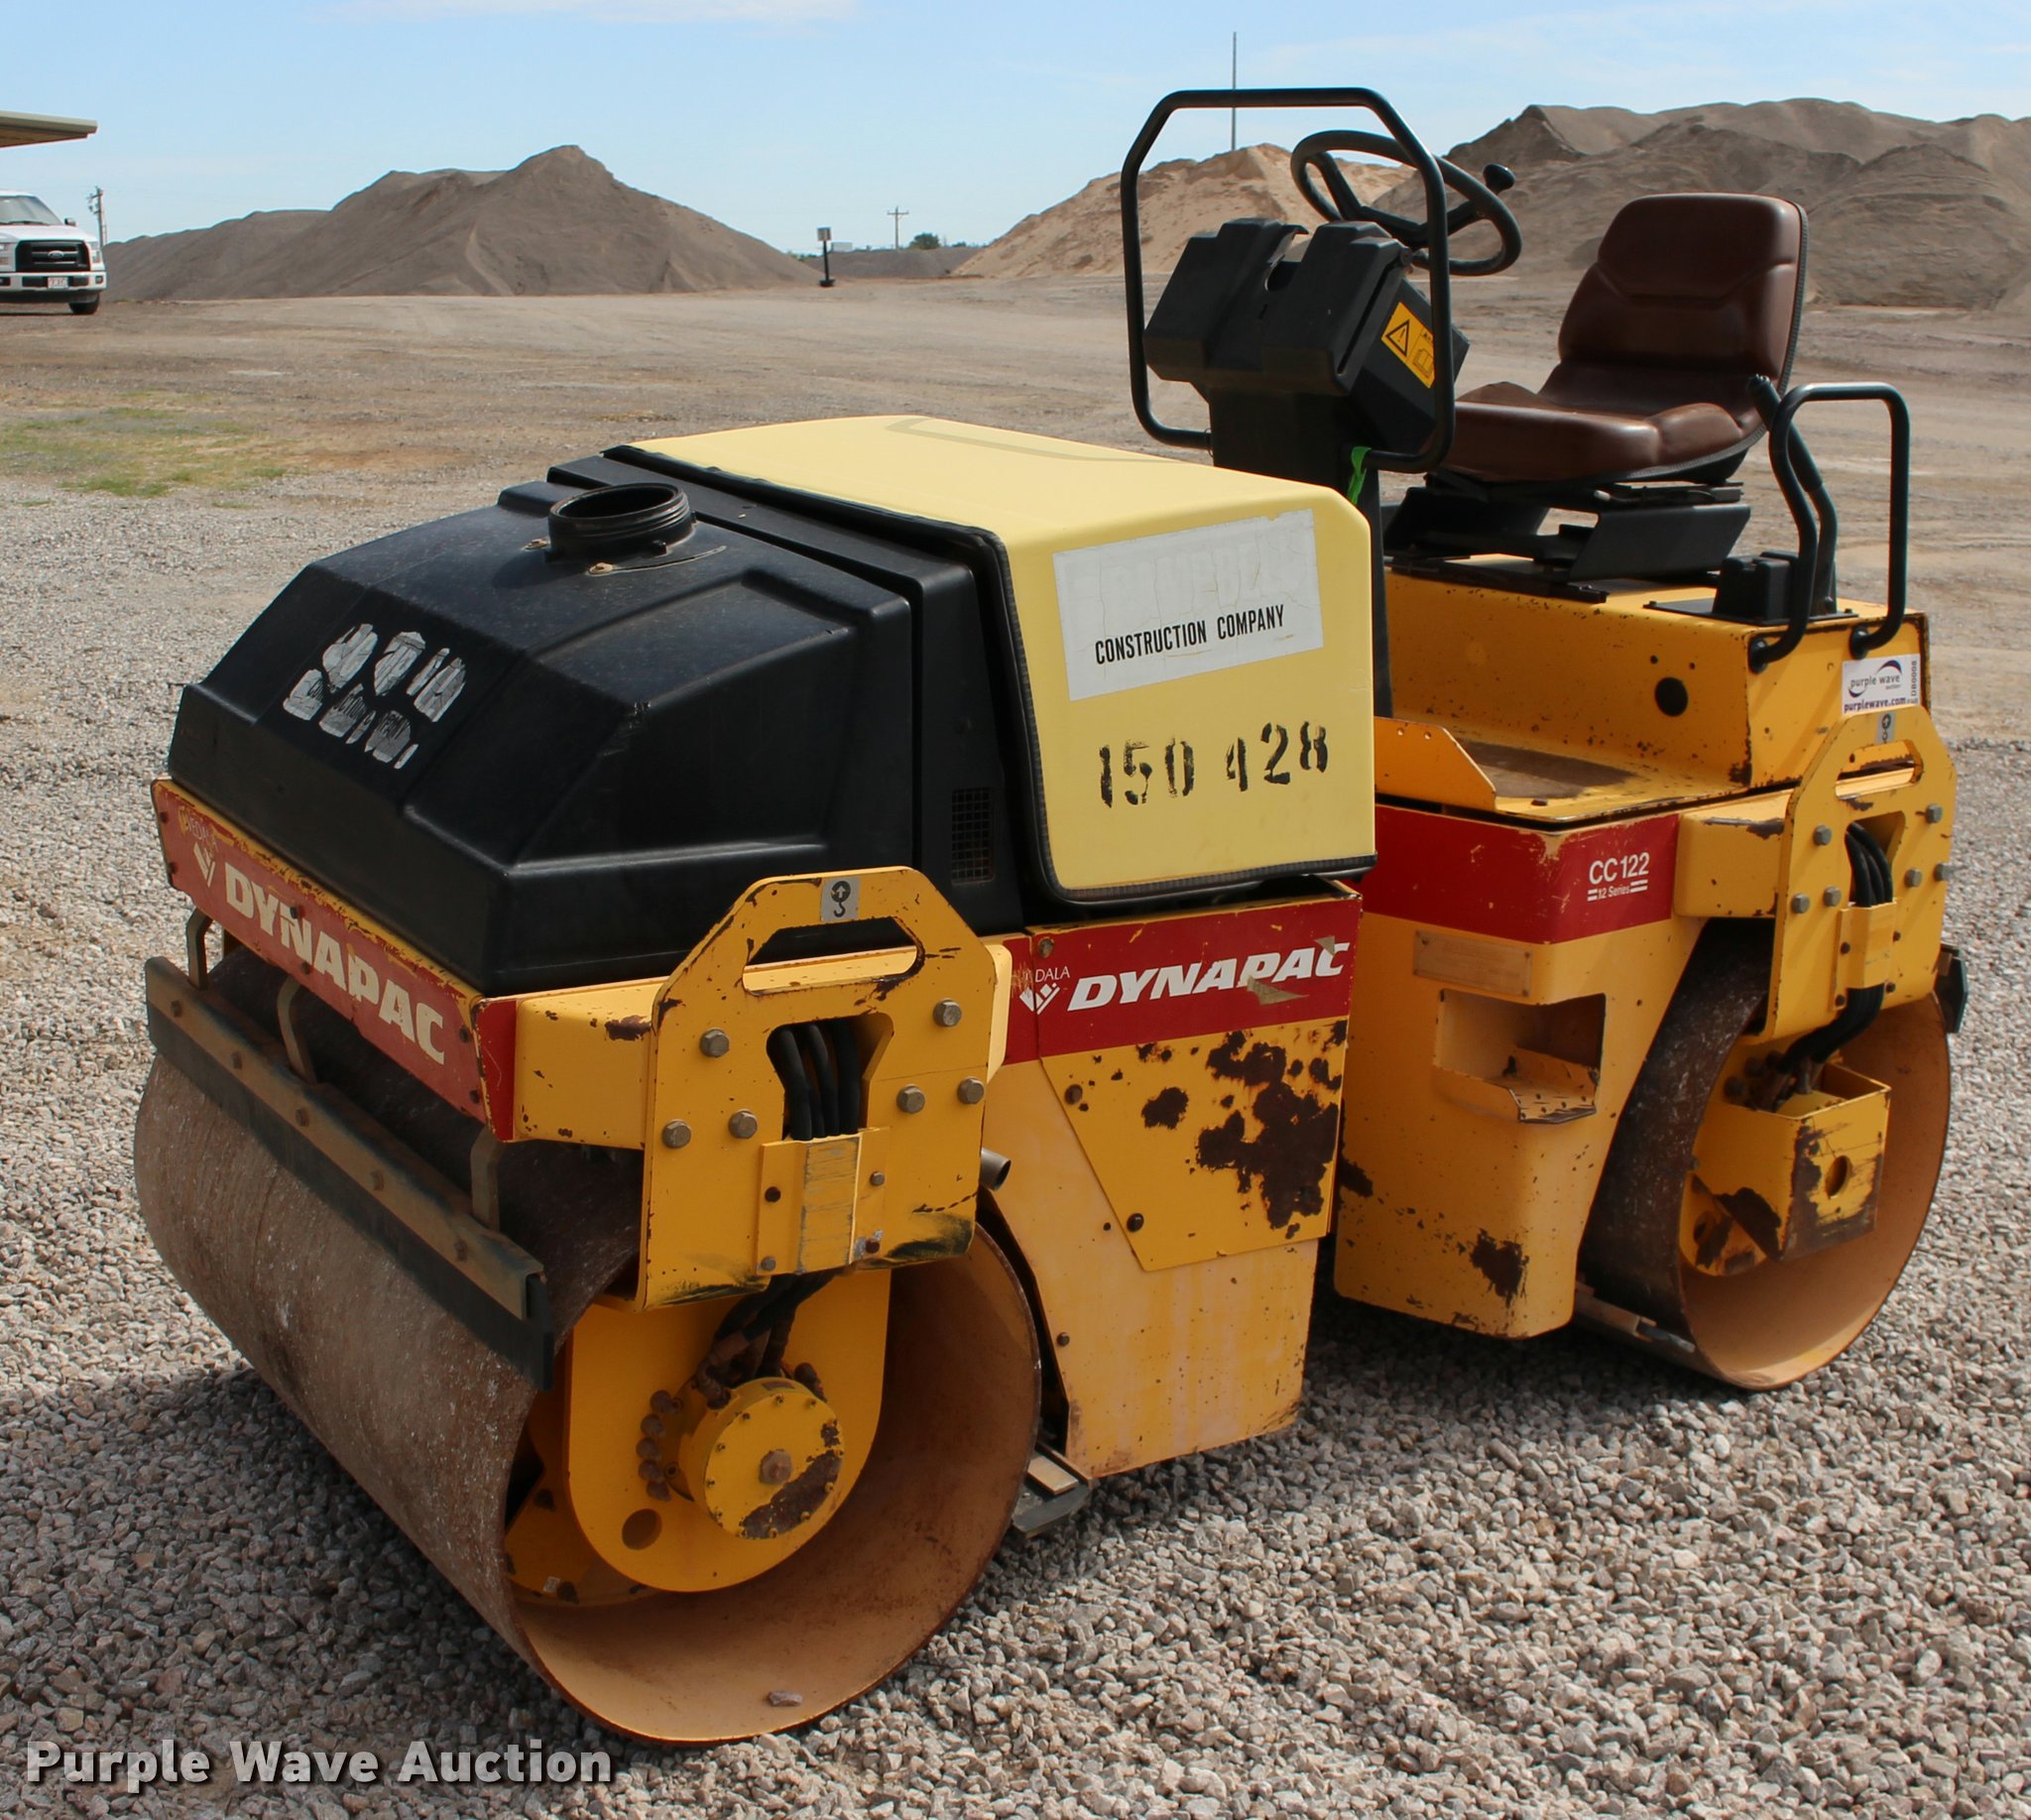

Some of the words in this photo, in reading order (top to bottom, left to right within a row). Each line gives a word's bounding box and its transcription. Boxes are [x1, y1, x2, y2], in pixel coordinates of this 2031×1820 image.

[1095, 620, 1208, 665] CONSTRUCTION
[1217, 604, 1285, 640] COMPANY
[1845, 697, 1905, 713] purplewave.com
[1851, 675, 1876, 689] purple
[1099, 736, 1195, 808] 150
[1225, 720, 1329, 793] 428
[1589, 858, 1618, 886] CC
[1619, 851, 1650, 880] 122
[1598, 888, 1607, 900] 12
[1608, 886, 1630, 897] Series
[226, 861, 445, 1067] DYNAPAC
[1067, 942, 1351, 1013] DYNAPAC
